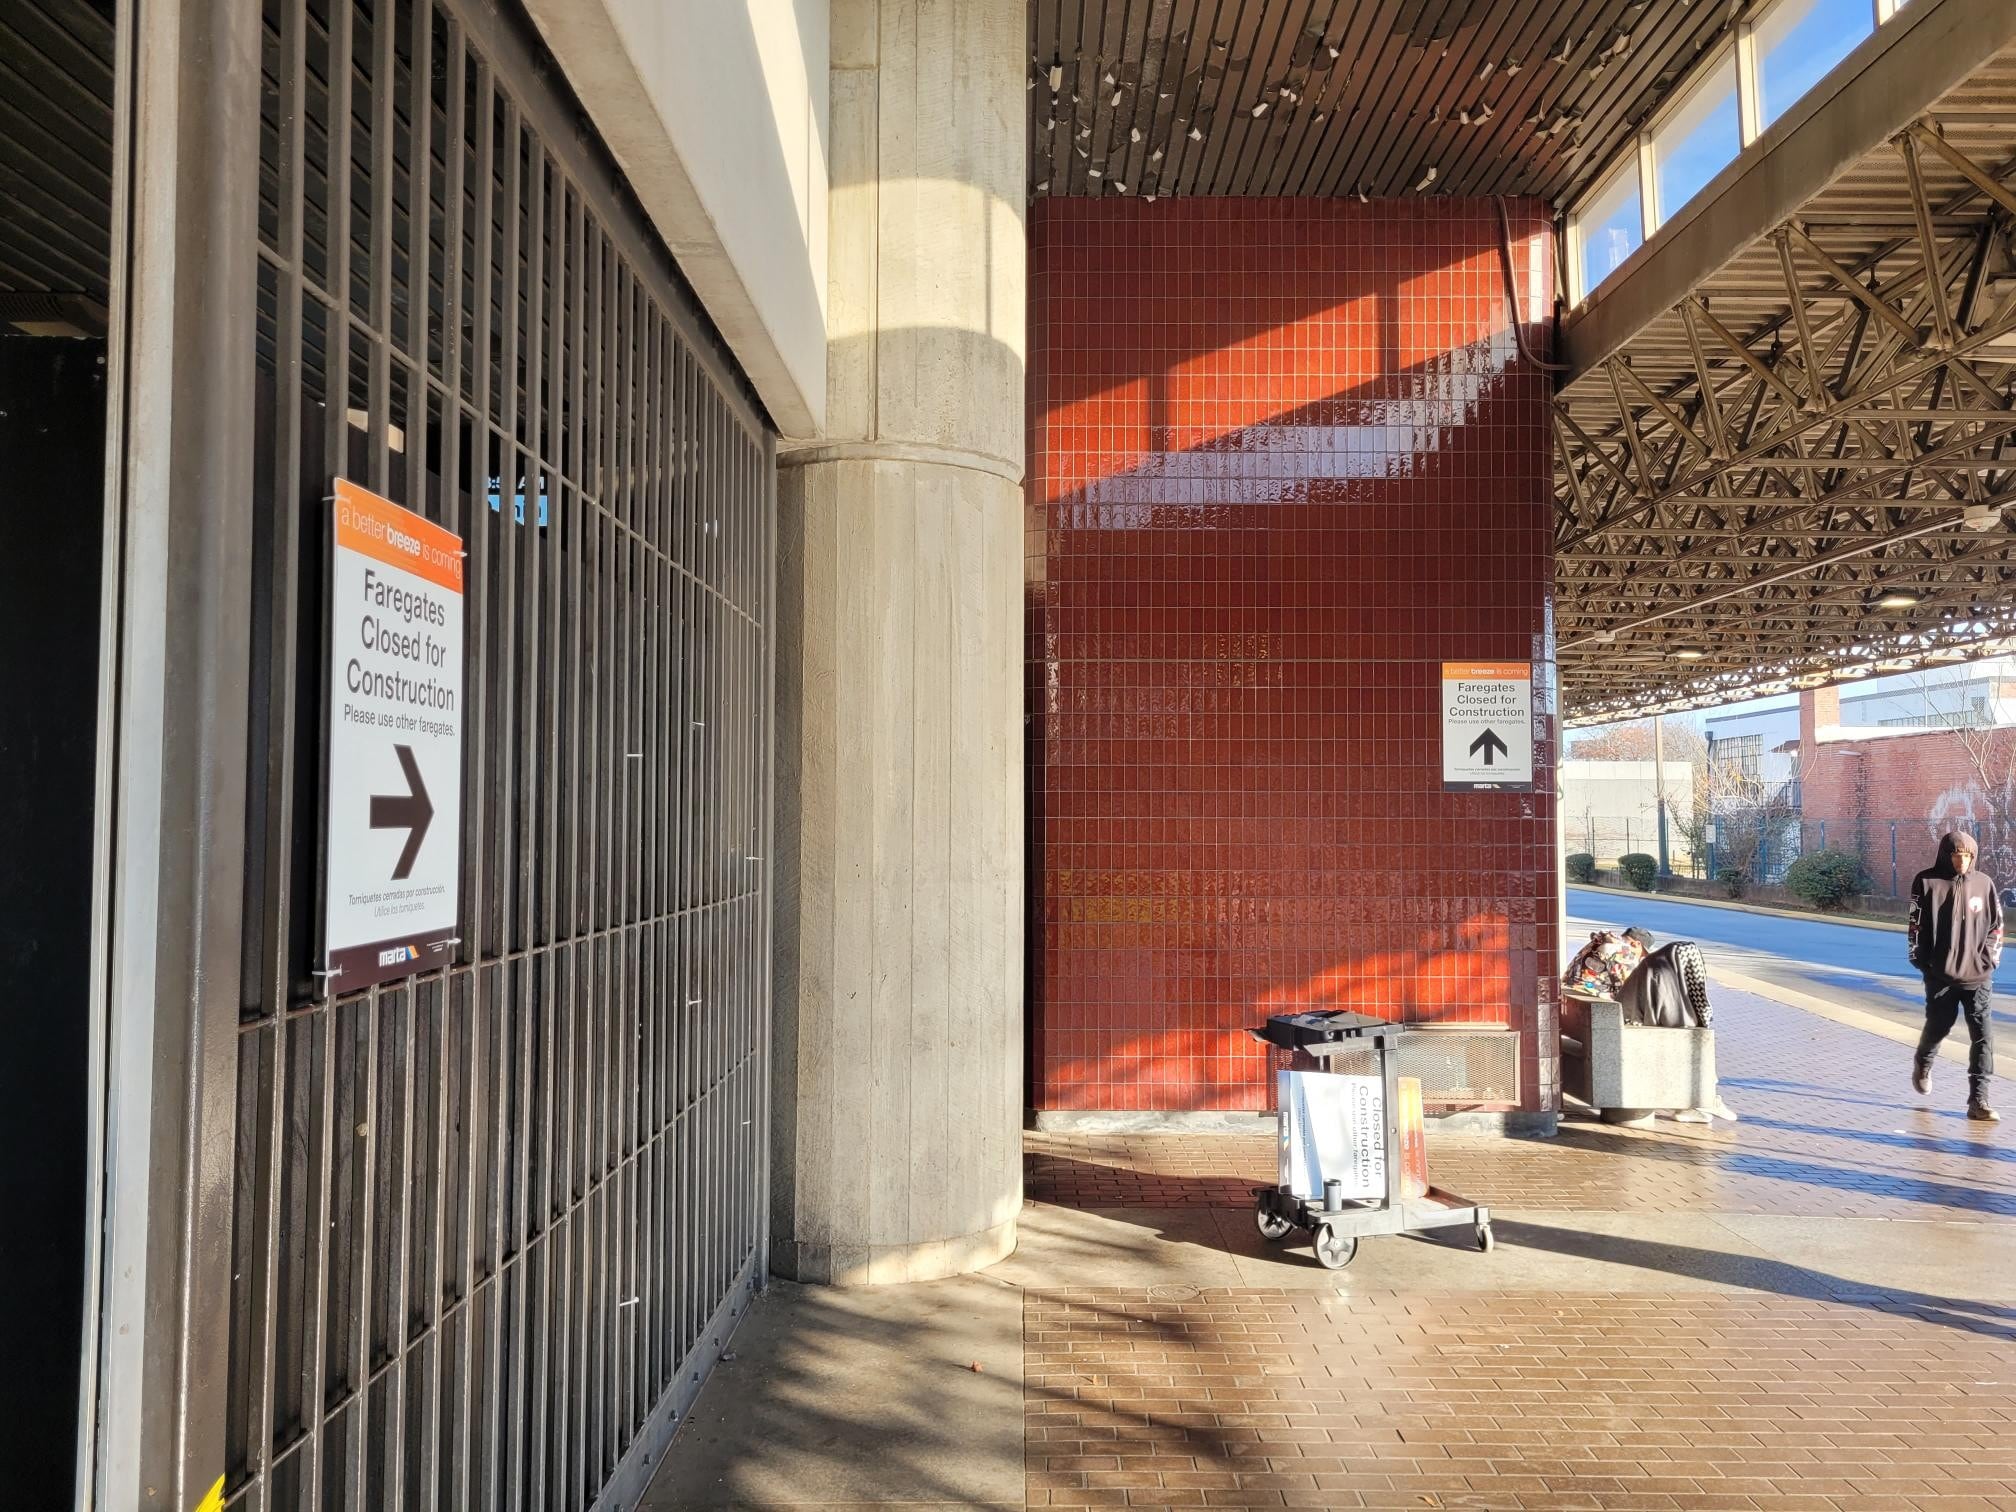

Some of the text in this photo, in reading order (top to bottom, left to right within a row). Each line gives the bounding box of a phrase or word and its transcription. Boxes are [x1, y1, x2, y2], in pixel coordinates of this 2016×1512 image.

[341, 508, 462, 579] a better breeze is coming
[364, 567, 445, 627] Faregates
[361, 615, 447, 668] Closed for
[346, 657, 455, 711] Construction
[1458, 683, 1515, 694] Faregates
[1471, 667, 1495, 675] breeze
[1503, 667, 1528, 676] coming
[343, 703, 456, 738] Please use other faregates.
[1449, 707, 1525, 717] Construction
[1457, 695, 1517, 705] Closed for
[379, 947, 406, 968] marta
[1359, 1085, 1371, 1188] Construction
[1372, 1097, 1384, 1177] Closed for
